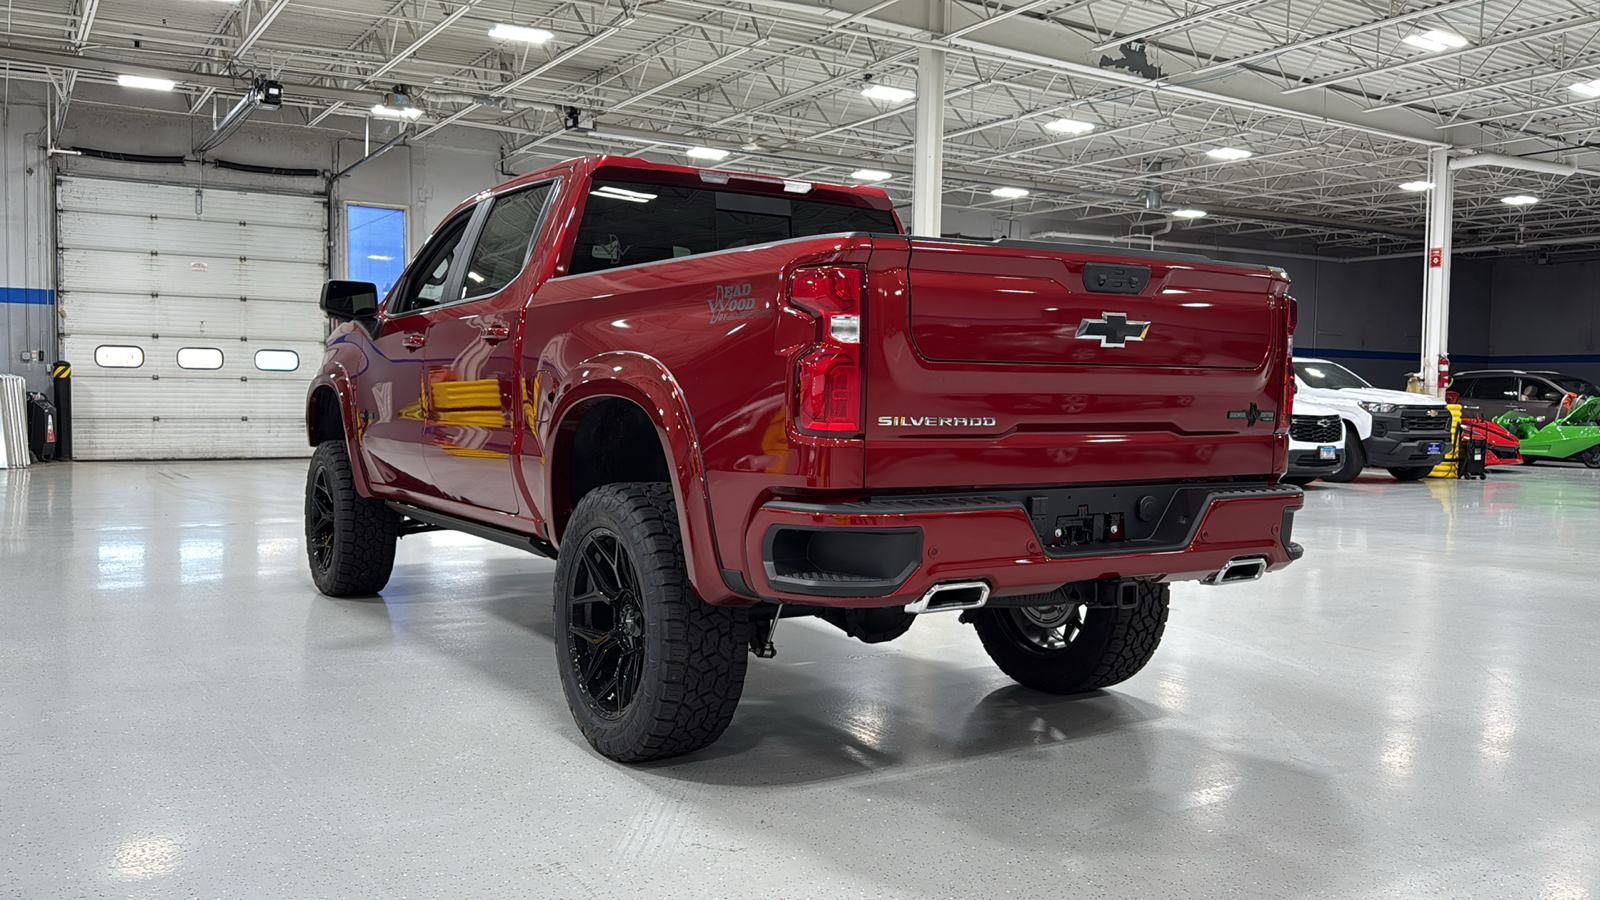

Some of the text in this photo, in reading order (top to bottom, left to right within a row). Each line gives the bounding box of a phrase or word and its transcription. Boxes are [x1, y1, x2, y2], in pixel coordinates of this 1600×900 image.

[715, 283, 752, 301] DEAD
[707, 298, 755, 313] WOOD
[877, 416, 997, 427] SILVERADO
